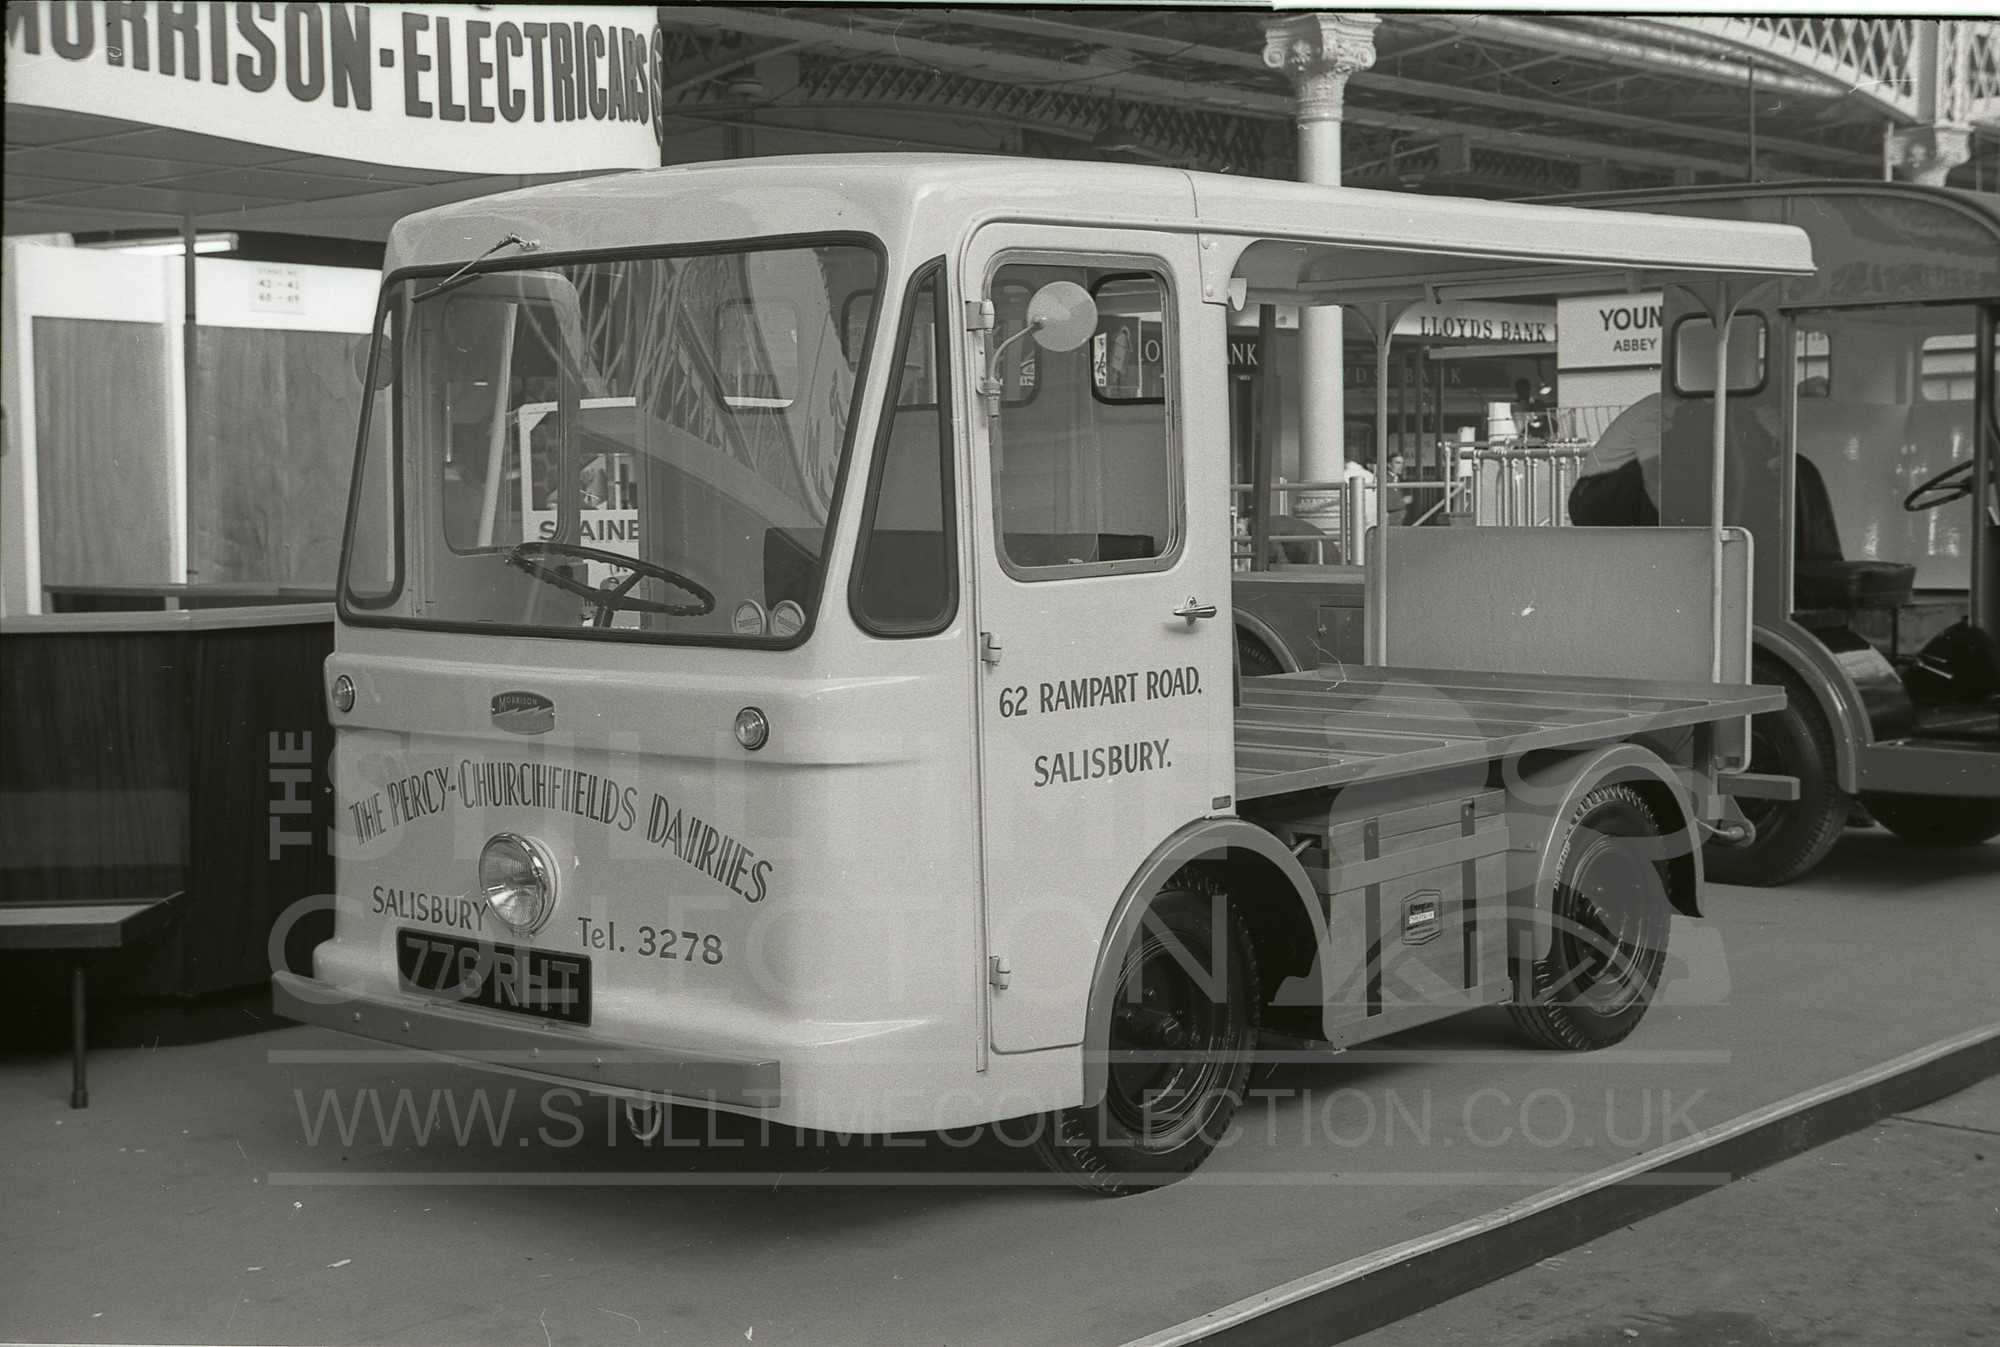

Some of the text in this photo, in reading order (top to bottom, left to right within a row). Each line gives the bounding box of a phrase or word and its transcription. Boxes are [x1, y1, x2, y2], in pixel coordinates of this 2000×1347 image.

[1420, 315, 1494, 339] LLOYDS
[1501, 320, 1547, 343] BANK
[1599, 305, 1663, 331] YOUN
[1612, 337, 1658, 352] ABBEY
[538, 519, 640, 541] SAINE
[999, 666, 1203, 718] 62 RAMPART ROAD.
[1033, 738, 1172, 788] SALISBURY.
[348, 792, 387, 846] THE
[647, 793, 774, 904] DAIRIES
[371, 885, 488, 932] SALISBURY
[577, 916, 724, 965] Tel. 3278
[494, 951, 581, 1015] RHT
